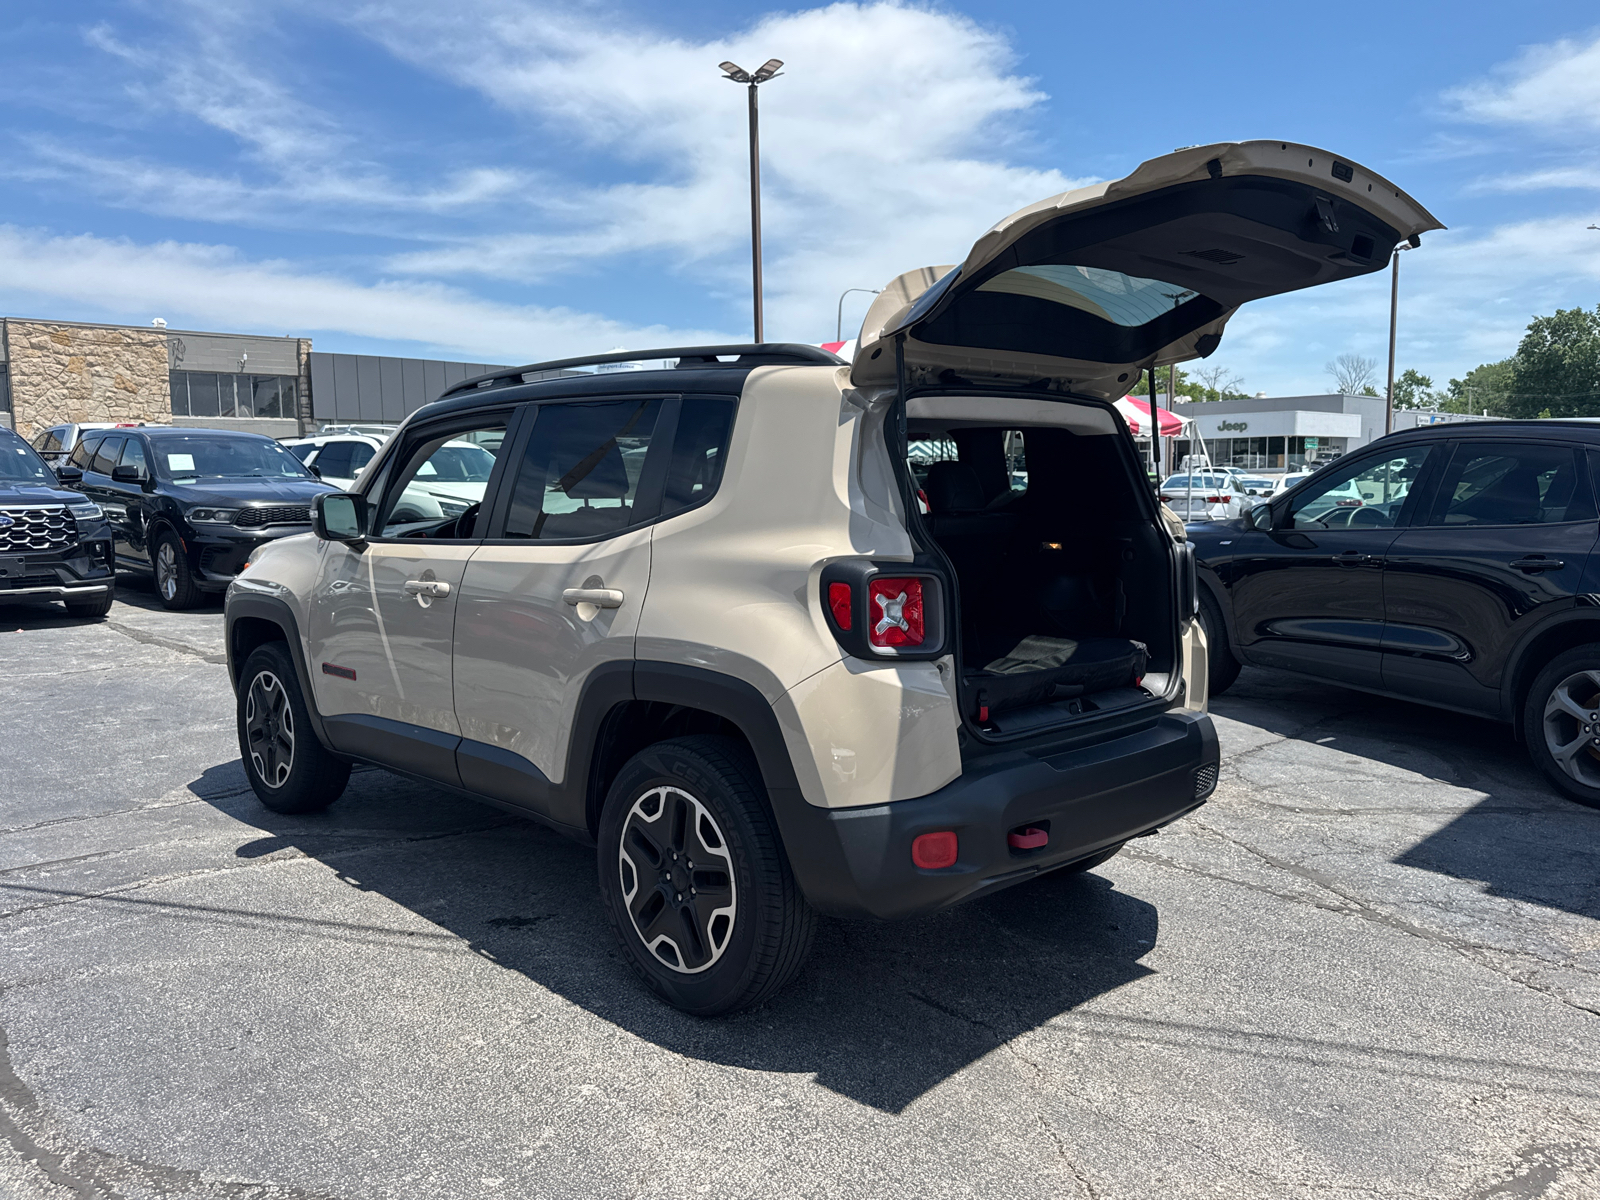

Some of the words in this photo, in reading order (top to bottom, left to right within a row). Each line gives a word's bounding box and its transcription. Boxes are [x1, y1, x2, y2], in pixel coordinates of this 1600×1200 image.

[1217, 420, 1248, 433] Jeep
[673, 761, 712, 793] CS5
[712, 796, 751, 887] GRAND
